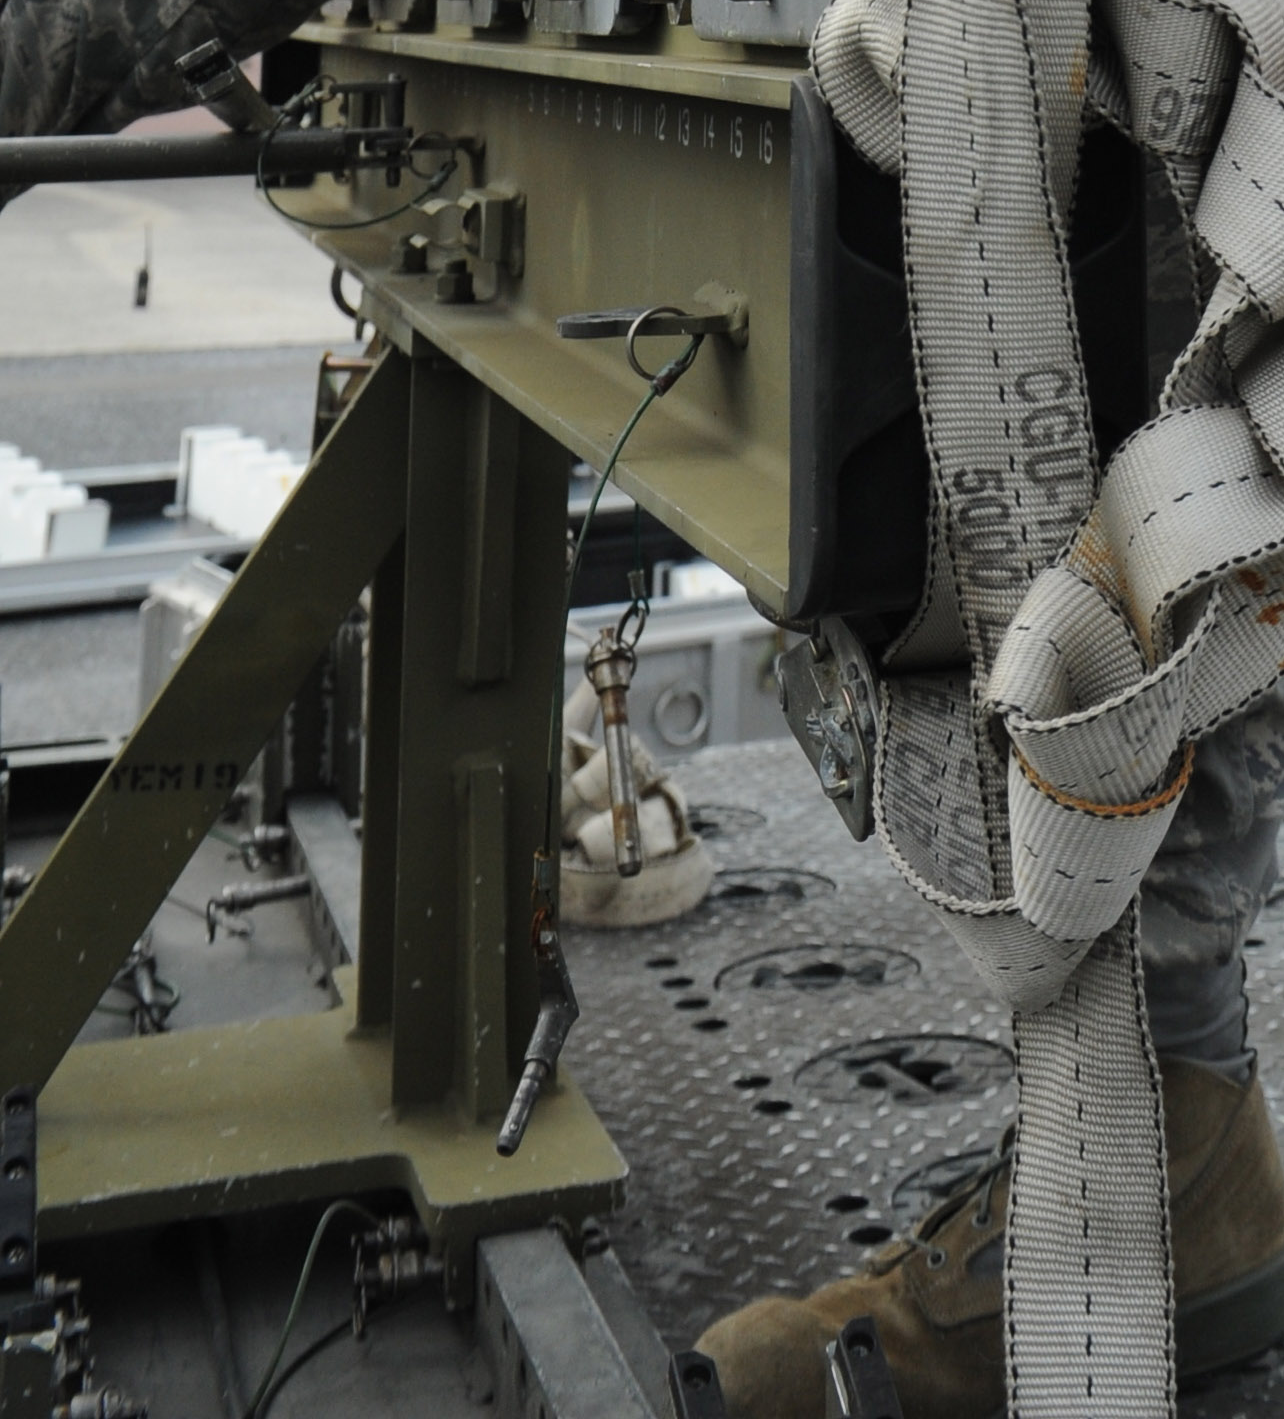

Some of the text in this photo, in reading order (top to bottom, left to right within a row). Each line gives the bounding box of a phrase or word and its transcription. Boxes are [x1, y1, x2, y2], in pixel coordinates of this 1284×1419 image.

[612, 96, 623, 132] 10
[633, 103, 643, 135] 11
[655, 103, 667, 141] 12
[677, 107, 691, 147] 13
[703, 114, 715, 149] 14
[730, 116, 744, 159] 15
[759, 120, 774, 165] 16
